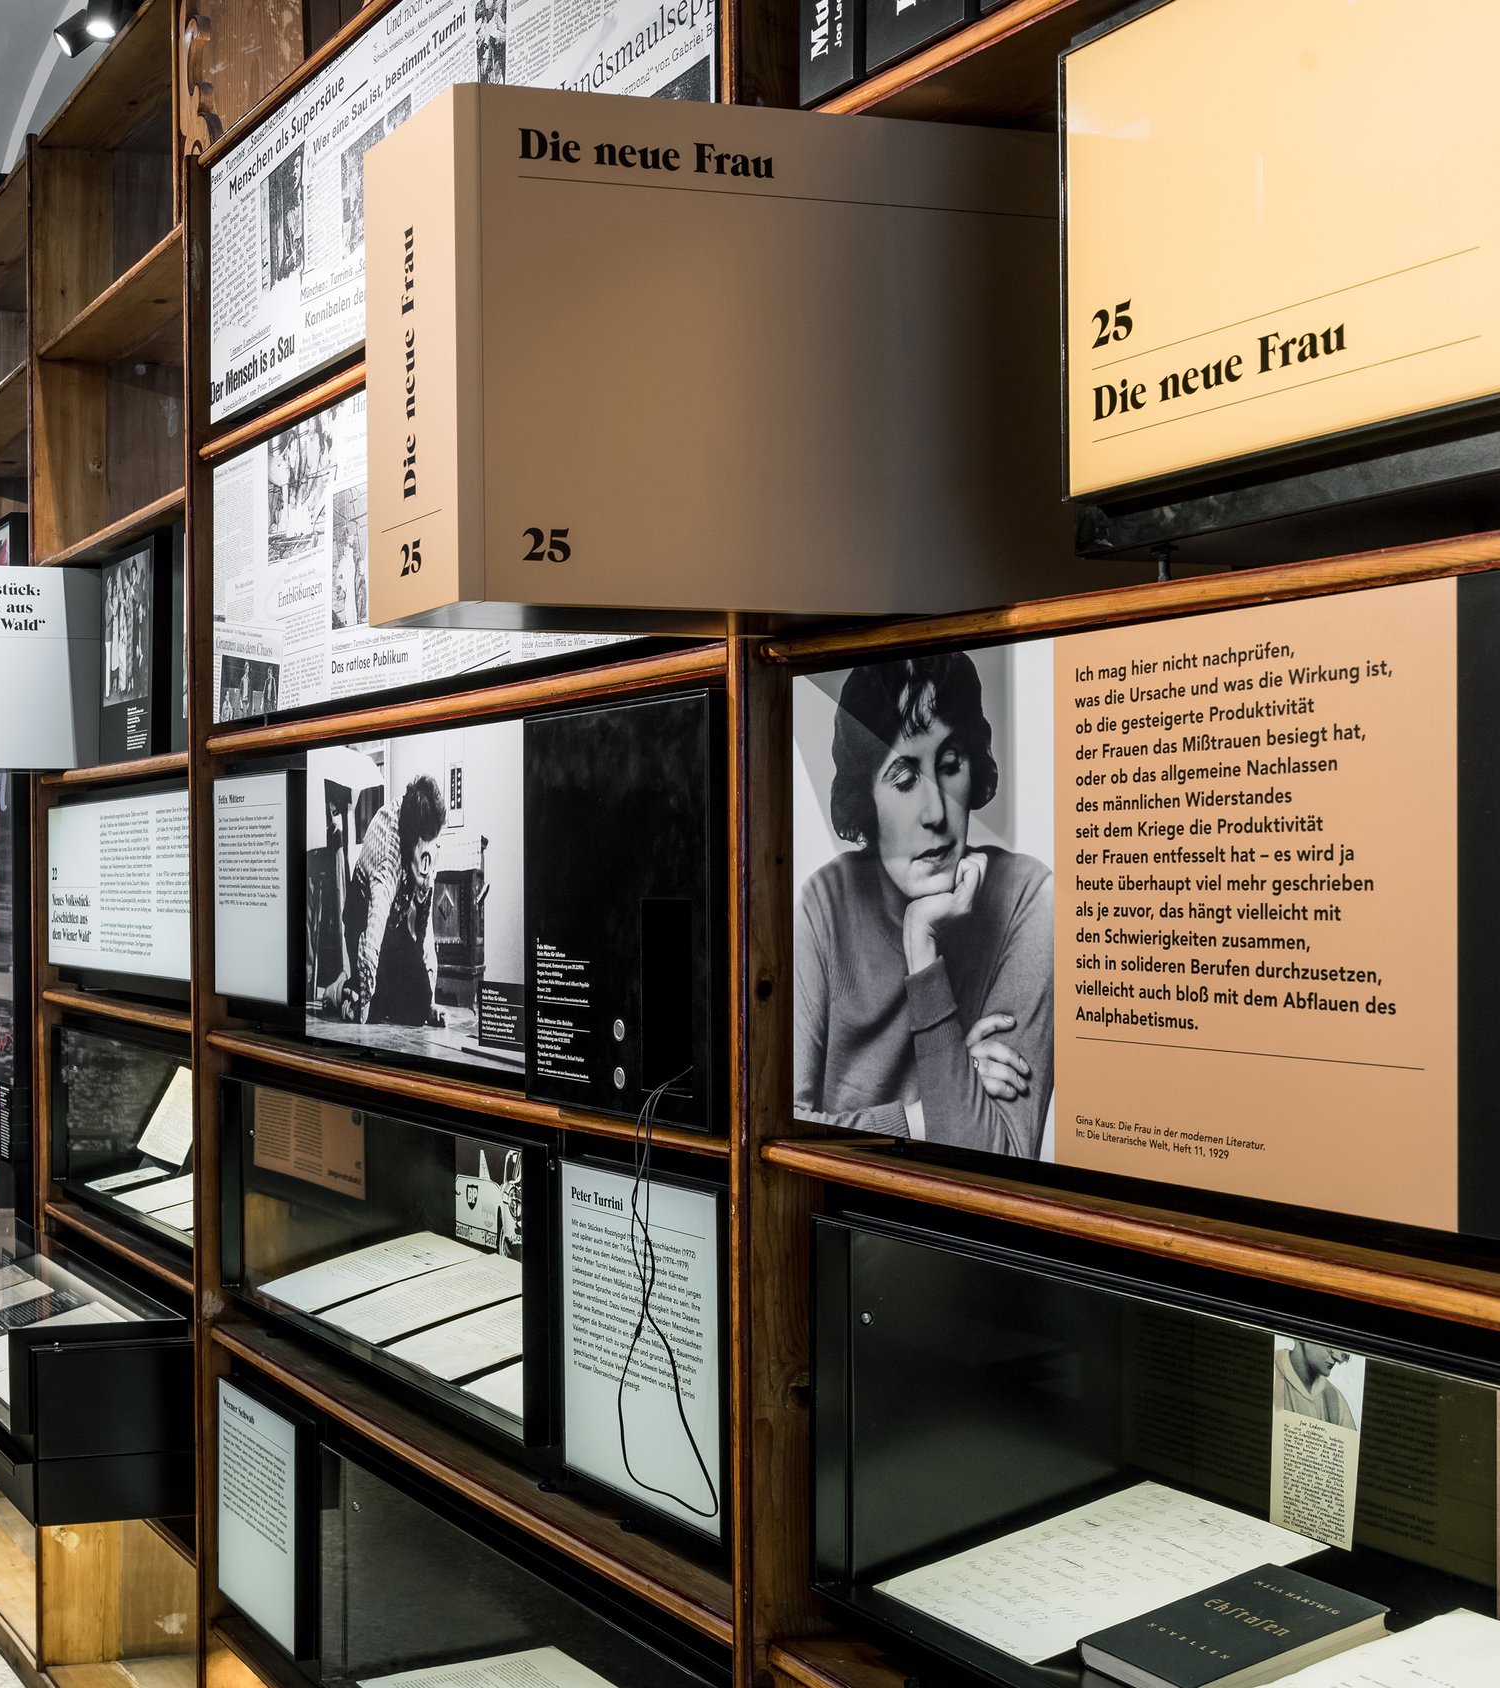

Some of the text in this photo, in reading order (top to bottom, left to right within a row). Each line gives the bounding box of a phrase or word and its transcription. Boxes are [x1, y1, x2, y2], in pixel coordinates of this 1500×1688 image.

[386, 10, 401, 36] Und
[654, 34, 703, 73] von Gabriel
[313, 6, 465, 154] Wer eine Sau ist, bestimmt Turrini
[230, 76, 344, 199] Menschen als Supersäue
[518, 128, 775, 179] Die neue Frau
[305, 298, 350, 328] Kannibalen
[1091, 299, 1133, 349] 25
[211, 334, 295, 404] Der Mensch is a Sau
[401, 225, 416, 502] Die neue Frau
[1093, 322, 1347, 421] Die neue Frau
[399, 537, 422, 578] 25
[523, 527, 571, 563] 25
[6, 603, 33, 613] aus
[277, 581, 323, 608] Entblößungen
[0, 618, 45, 631] Wald“
[216, 637, 272, 657] Grunzen aus dem Chaos
[332, 648, 408, 674] Das ratlose Publikum
[1075, 642, 1295, 683] Ich mag hier nicht nachprüfen,
[1075, 659, 1393, 708] was die Ursache und was die Wirkung ist,
[218, 794, 245, 805] Felix Mitterer
[52, 867, 57, 880] 22
[1075, 1006, 1199, 1030] Analphabetismus.
[1076, 1115, 1266, 1151] Gina Kaus: Die Frau in der modernen Literatur.
[1076, 1129, 1229, 1159] In: Die Literarische Welt, Heft 11, 1929
[468, 1187, 478, 1203] BP
[571, 1186, 623, 1211] Peter Turrini
[223, 1396, 255, 1425] Werner Schwab
[1254, 1580, 1340, 1615] MELA HARTWIG
[1148, 1623, 1229, 1660] NOVELLEN
